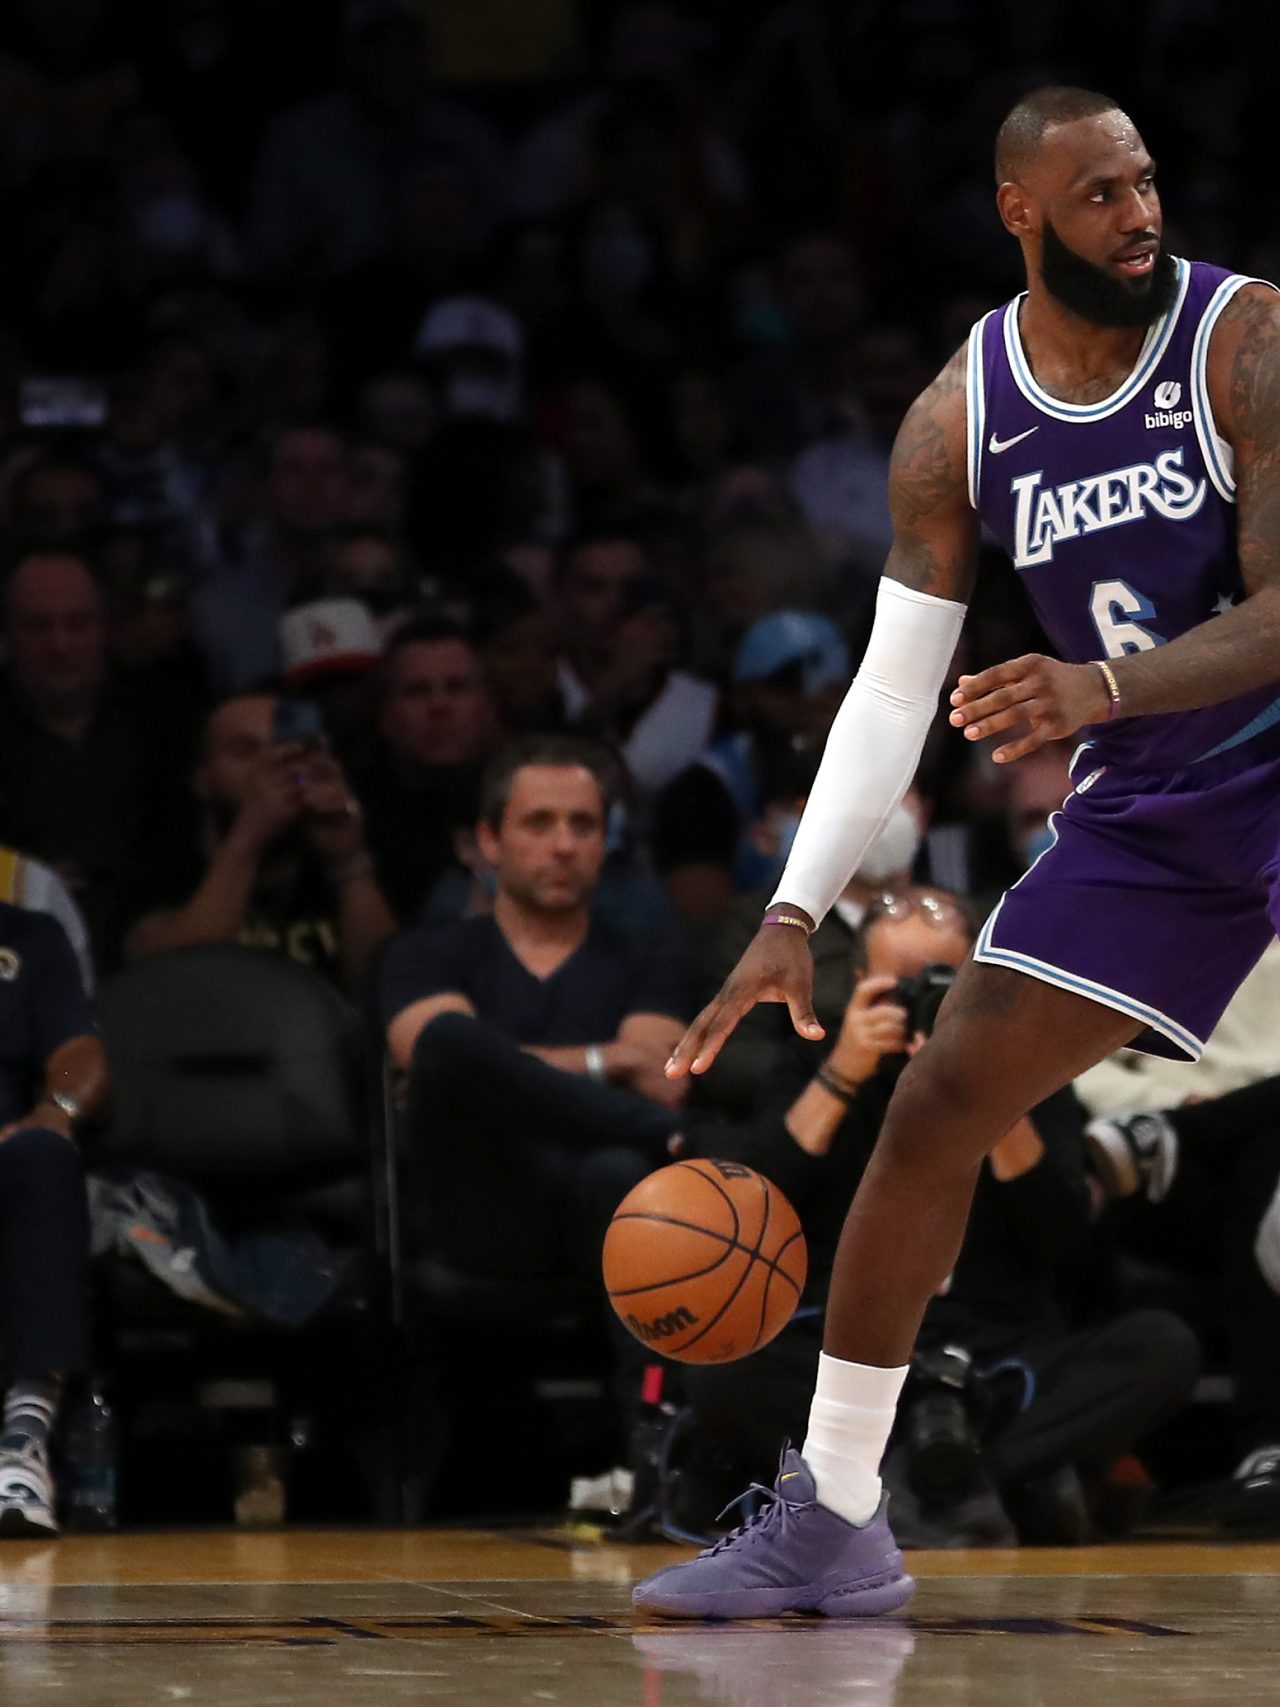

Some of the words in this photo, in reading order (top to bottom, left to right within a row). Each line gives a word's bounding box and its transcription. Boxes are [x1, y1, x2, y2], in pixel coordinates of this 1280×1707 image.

[1145, 410, 1192, 429] bibigo
[1011, 446, 1206, 570] LAKERS
[1089, 579, 1166, 659] 6
